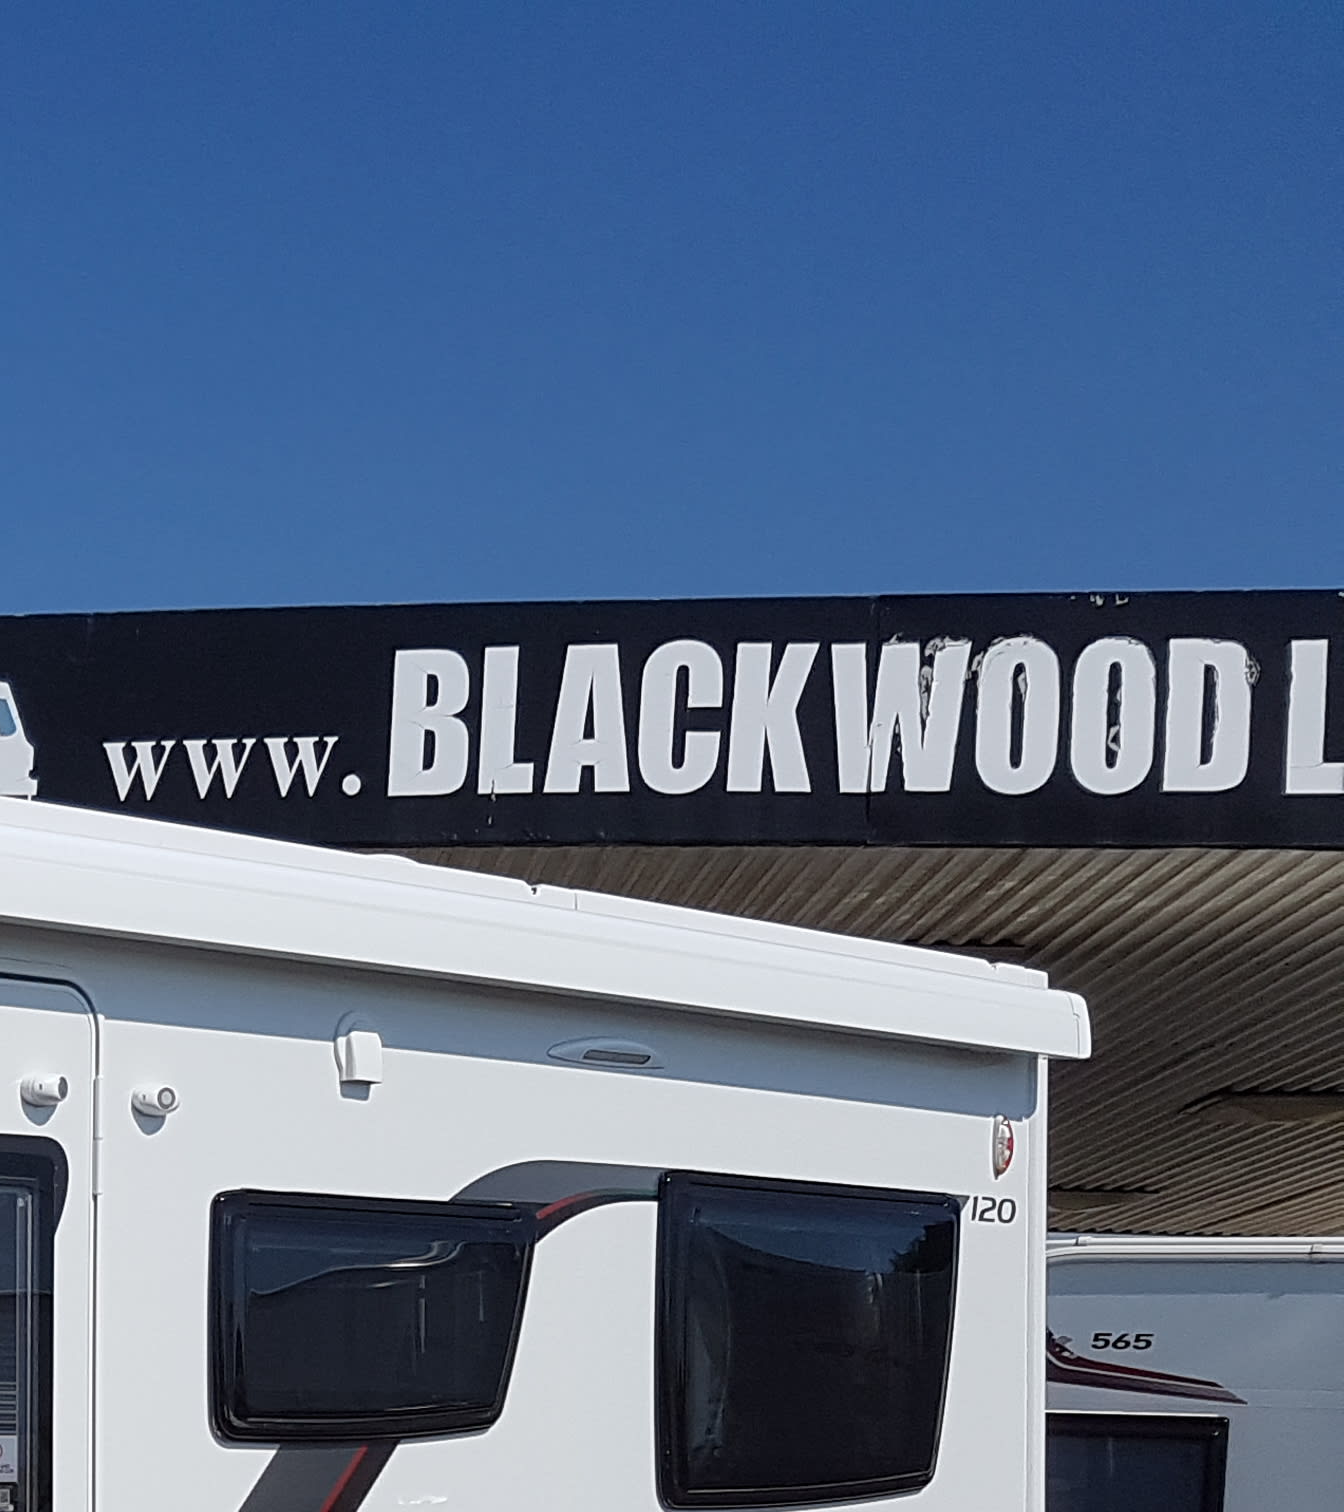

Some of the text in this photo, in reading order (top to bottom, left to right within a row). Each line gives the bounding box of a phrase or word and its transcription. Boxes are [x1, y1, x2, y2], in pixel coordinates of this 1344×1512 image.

[387, 634, 1253, 797] BLACKWOOD
[971, 1195, 1017, 1224] 120
[1090, 1332, 1155, 1350] 565
